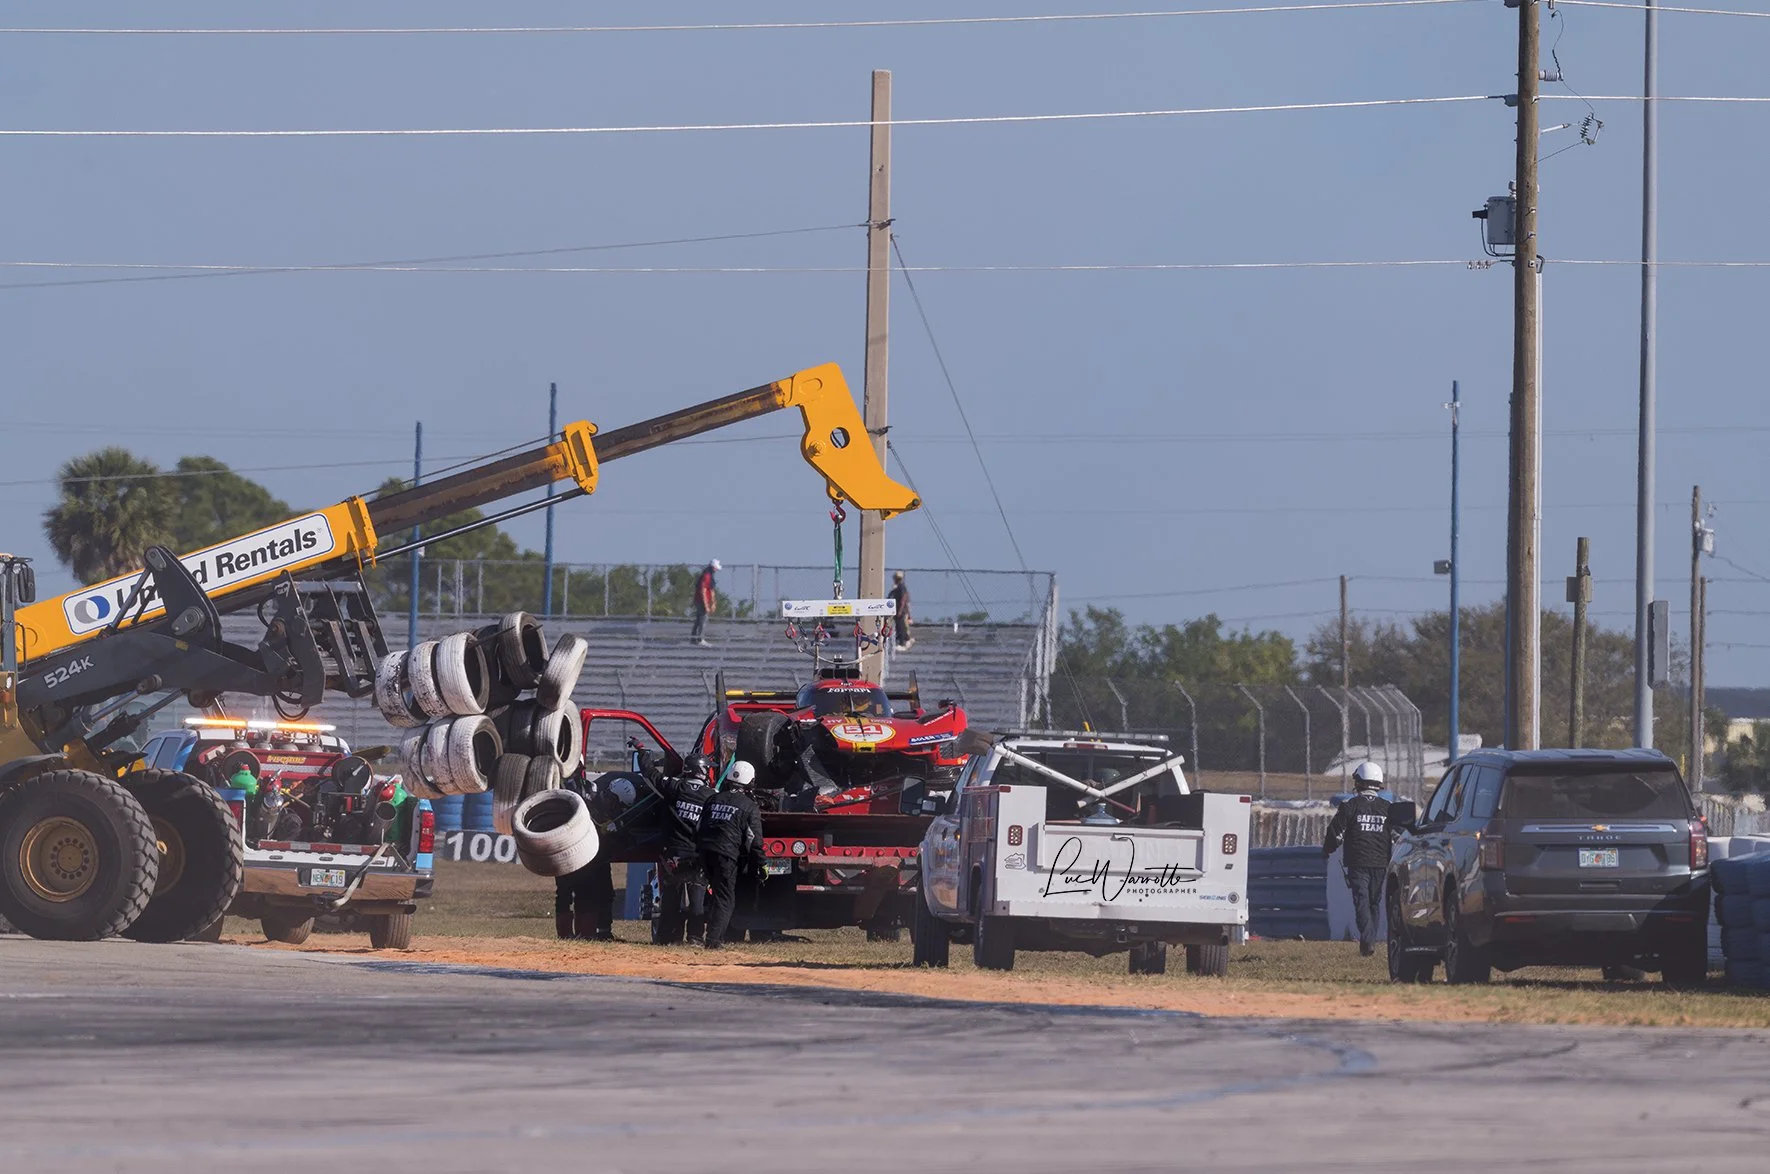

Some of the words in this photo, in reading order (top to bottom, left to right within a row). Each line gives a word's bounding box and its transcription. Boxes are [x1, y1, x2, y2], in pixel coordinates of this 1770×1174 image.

[216, 529, 318, 578] Rentals
[44, 656, 94, 688] 524K
[845, 725, 881, 734] 51
[711, 803, 739, 814] SAFETY
[678, 810, 700, 822] TEAM
[711, 811, 732, 821] TEAM
[1357, 814, 1387, 824] SAFETY
[1361, 823, 1383, 832] TEAM
[447, 832, 517, 863] 100
